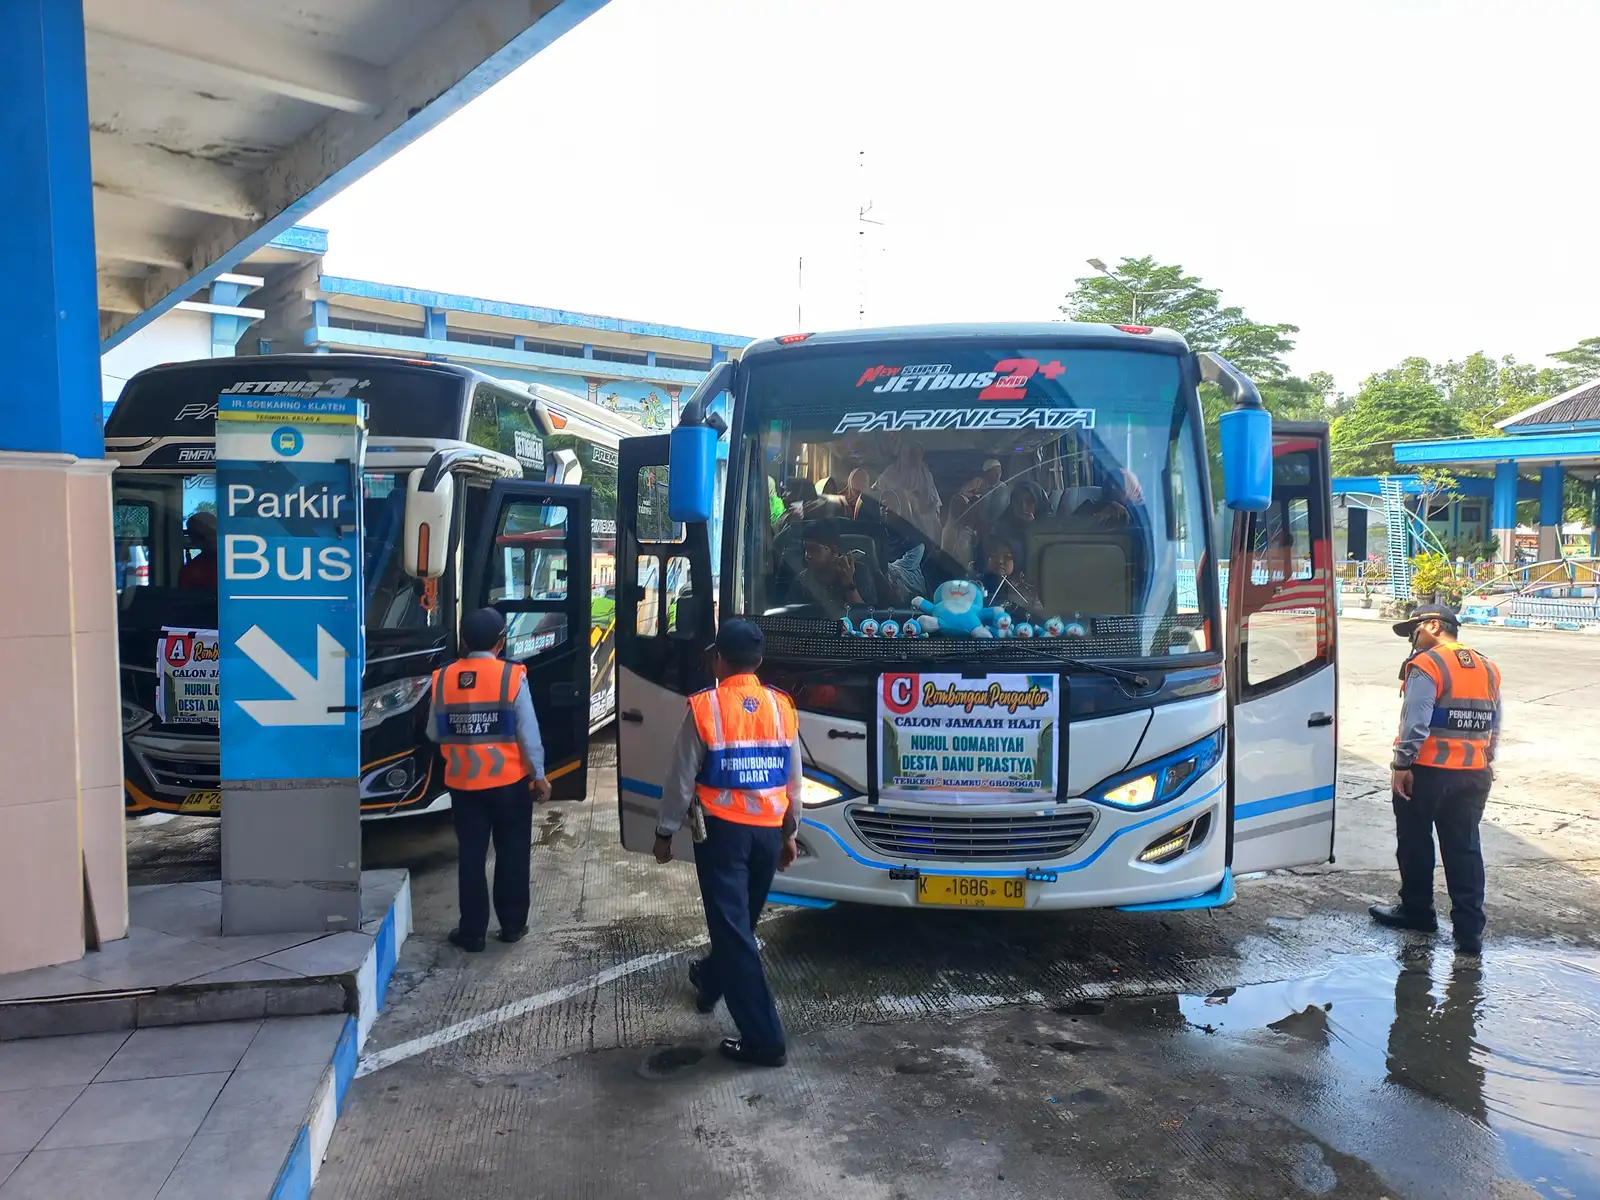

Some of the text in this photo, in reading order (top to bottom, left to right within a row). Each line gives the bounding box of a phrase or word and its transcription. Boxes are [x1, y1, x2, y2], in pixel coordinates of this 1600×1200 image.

[902, 364, 952, 375] SUPER
[221, 381, 321, 393] JETBUS
[873, 372, 998, 393] JETBUS
[232, 400, 244, 408] IR.
[308, 402, 345, 411] KLATEN
[833, 408, 1096, 434] PARIWISATA
[228, 484, 345, 518] Parkir
[225, 534, 352, 581] Bus
[169, 639, 186, 660] A
[172, 669, 207, 678] CALON
[184, 683, 213, 696] NURUL
[890, 677, 913, 706] C
[922, 681, 1049, 714] Rombongan Pengantar
[178, 699, 206, 712] DESTA
[455, 722, 491, 734] DARAT
[894, 716, 1042, 730] CALON JAMAAH HAJI
[1457, 719, 1486, 730] DARAT
[910, 735, 1025, 753] NURUL QOMARIYAH
[720, 756, 785, 771] PERHUBUNGAN
[901, 755, 1033, 773] DESTA DANU PRASTYA
[739, 769, 770, 784] DARAT
[893, 777, 936, 786] TERKESI
[942, 779, 982, 788] KLAMBU
[988, 780, 1042, 789] GROBOGAN
[919, 876, 1023, 898] K 1686 CB
